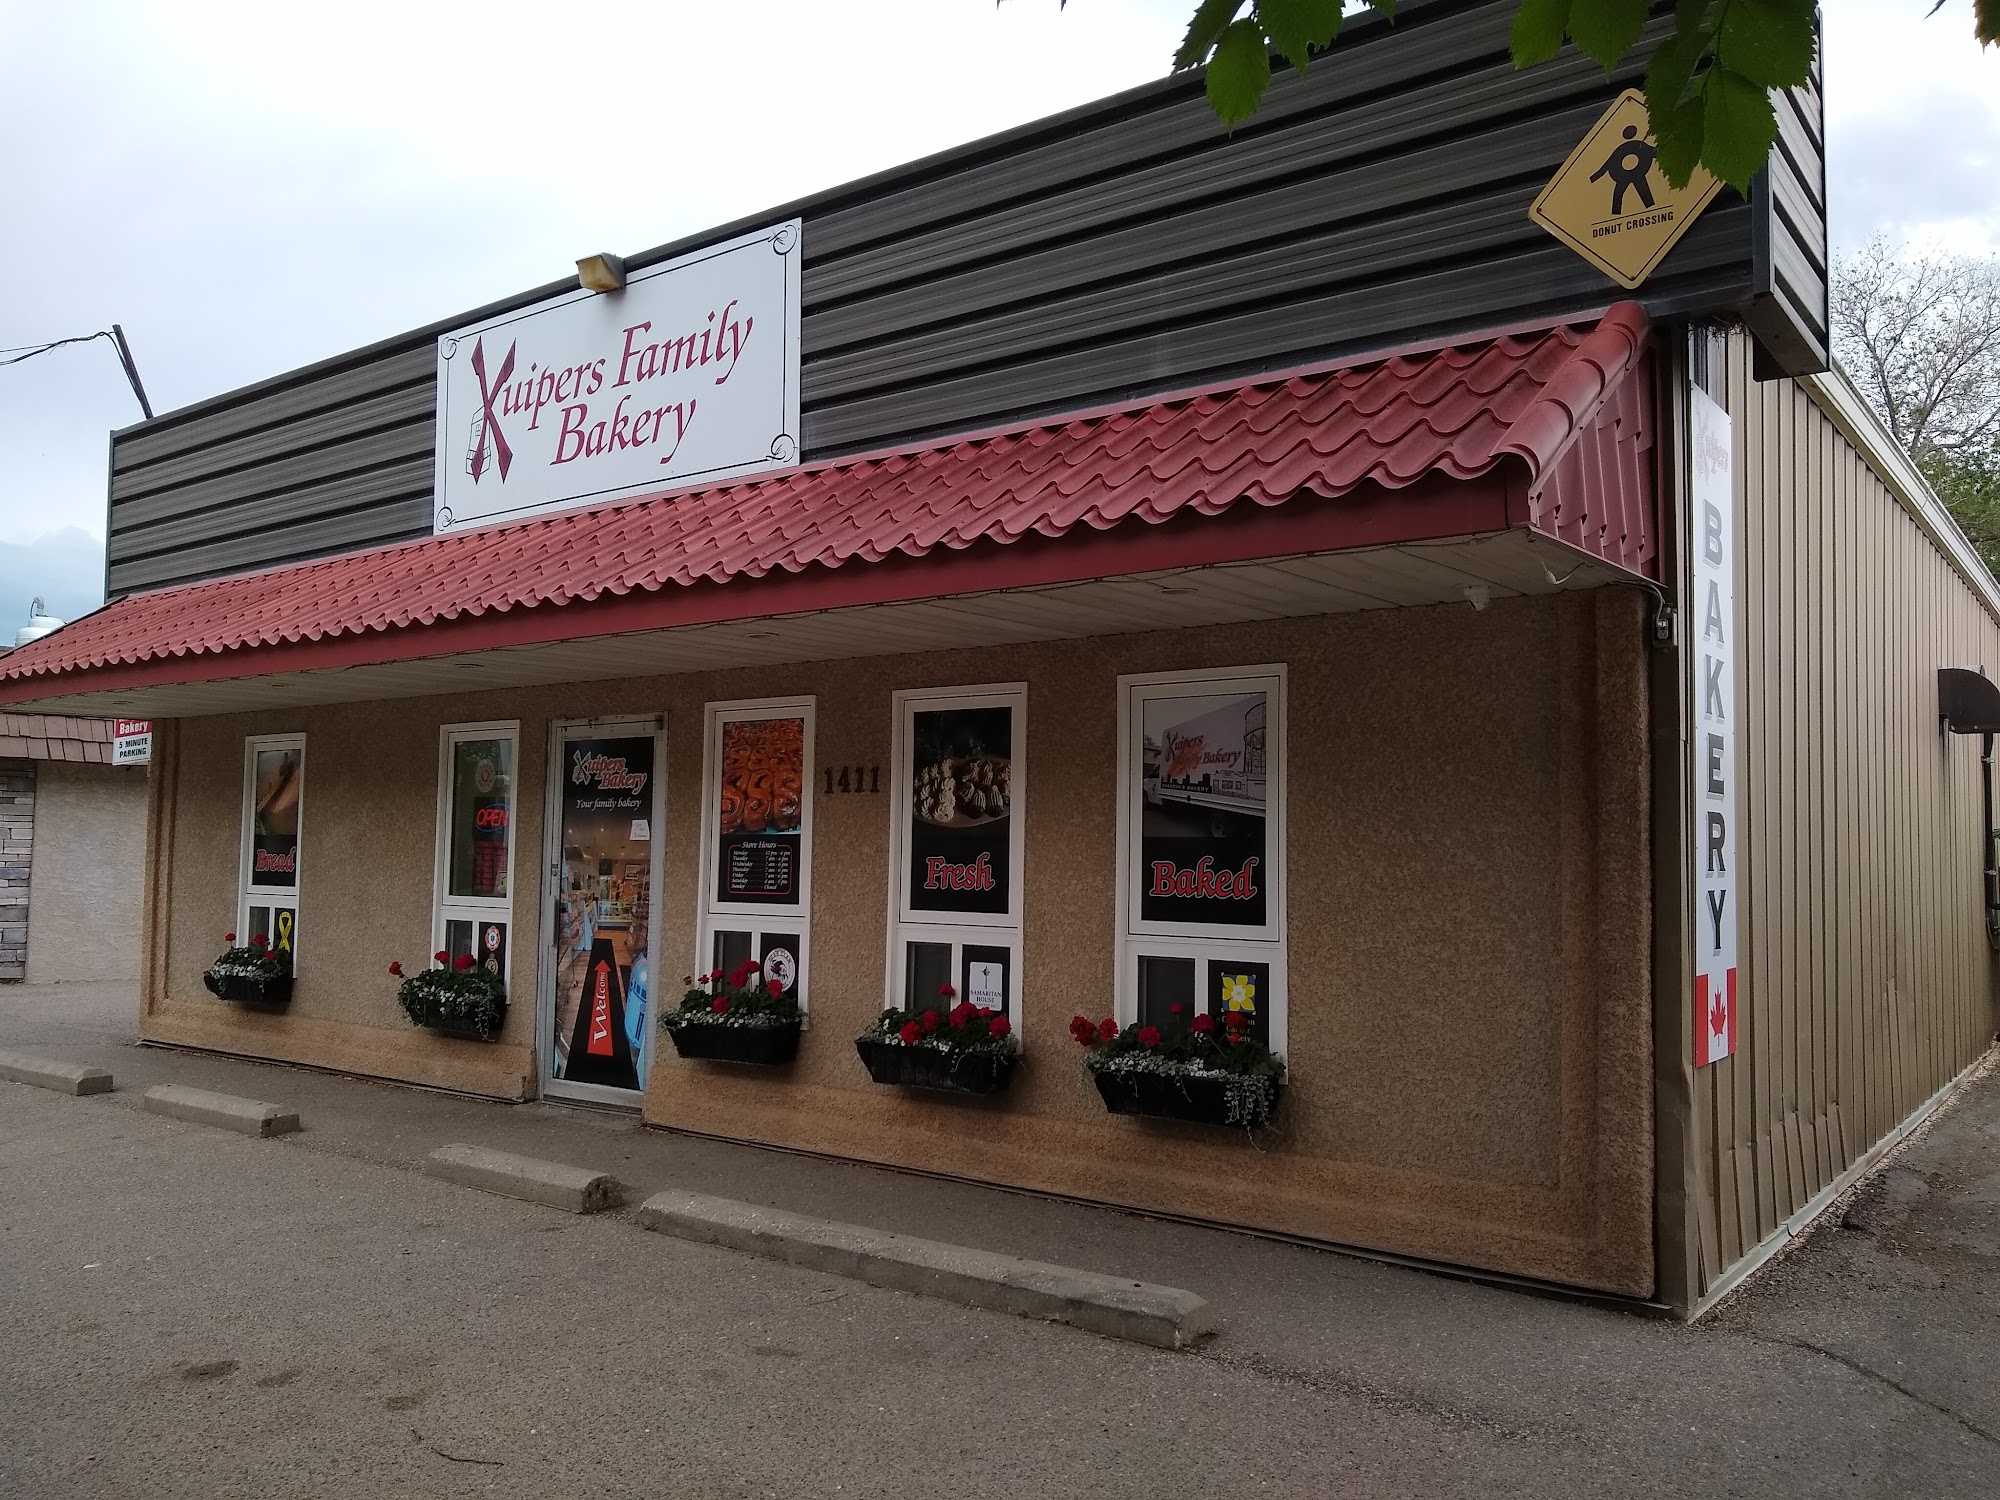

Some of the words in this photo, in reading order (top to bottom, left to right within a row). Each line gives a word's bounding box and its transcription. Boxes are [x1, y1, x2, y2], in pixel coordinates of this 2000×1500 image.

[1592, 223, 1623, 238] DONUT
[1626, 211, 1674, 231] CROSSING
[471, 335, 606, 486] Kuipers
[611, 299, 754, 388] Family
[549, 394, 697, 466] Bakery
[119, 721, 149, 735] Bakery
[1703, 498, 1727, 956] BAKERY
[119, 741, 123, 749] 5
[125, 737, 148, 748] MINUTE
[119, 747, 147, 758] PARKING
[572, 749, 626, 785] Kuipers
[1201, 747, 1242, 769] Bakery
[598, 768, 648, 796] Bakery
[824, 765, 880, 794] 1411
[476, 807, 510, 827] OPEN
[576, 799, 593, 809] Your
[591, 797, 617, 812] family
[617, 796, 642, 812] bakery
[255, 846, 297, 873] Bread
[923, 851, 996, 892] Fresh
[1149, 855, 1260, 901] Baked
[593, 971, 608, 1045] Welcome
